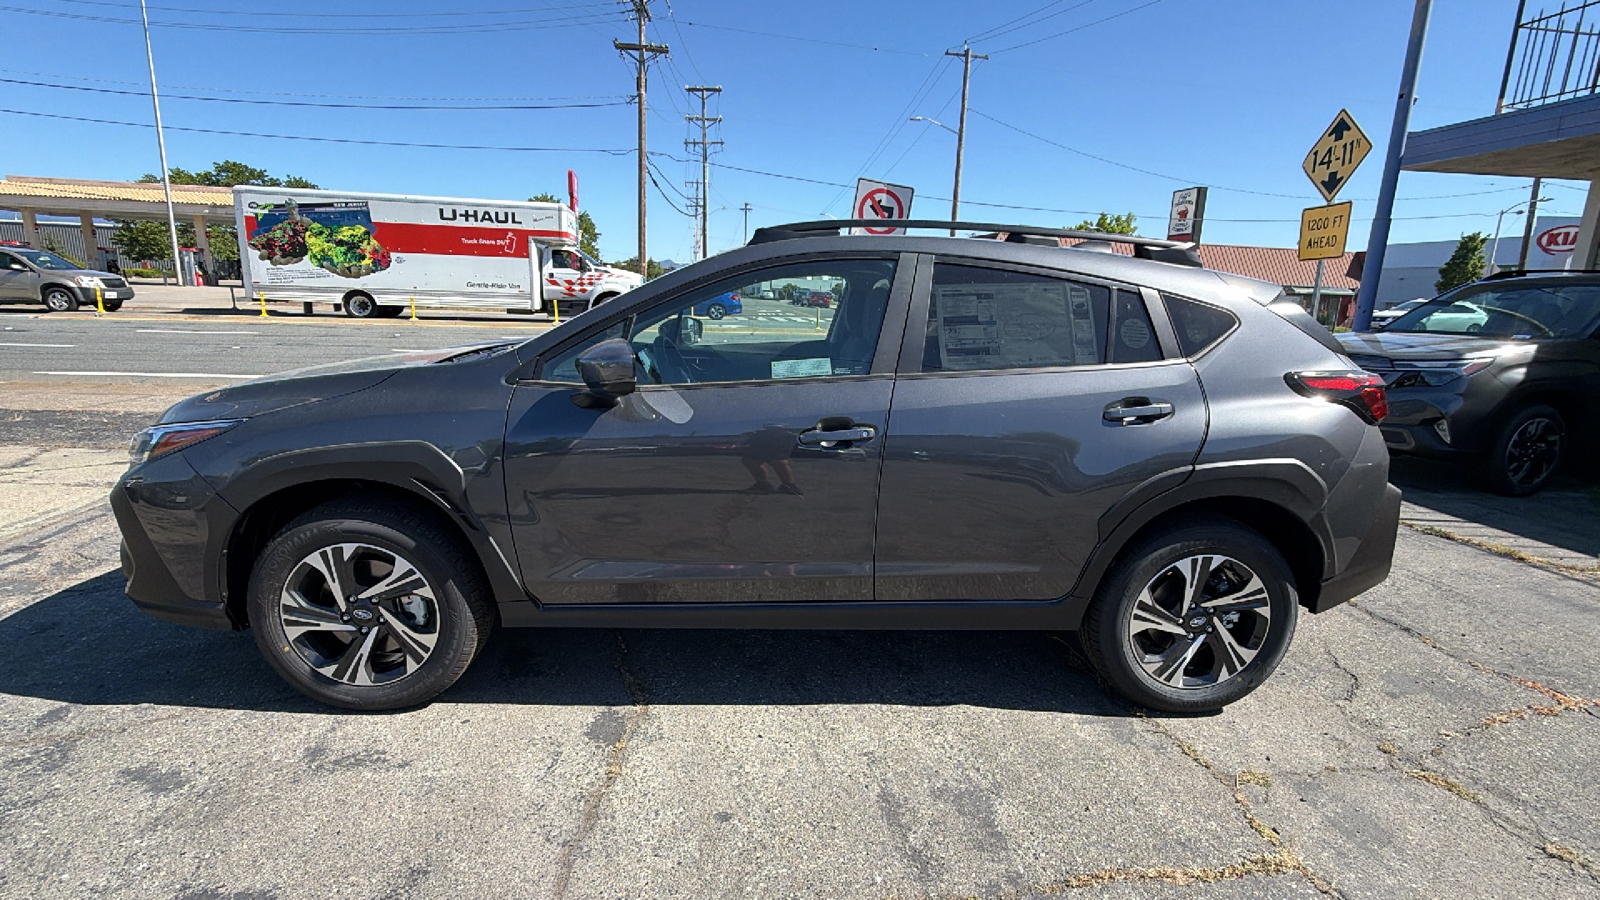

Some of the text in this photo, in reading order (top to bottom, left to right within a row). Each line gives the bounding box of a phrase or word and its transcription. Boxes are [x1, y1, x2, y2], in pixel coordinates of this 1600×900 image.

[439, 208, 523, 225] U-HAUL
[1307, 214, 1344, 231] 1200 FT
[461, 237, 478, 245] Truck
[1306, 234, 1338, 250] AHEAD
[466, 281, 507, 290] Gentle-Ride
